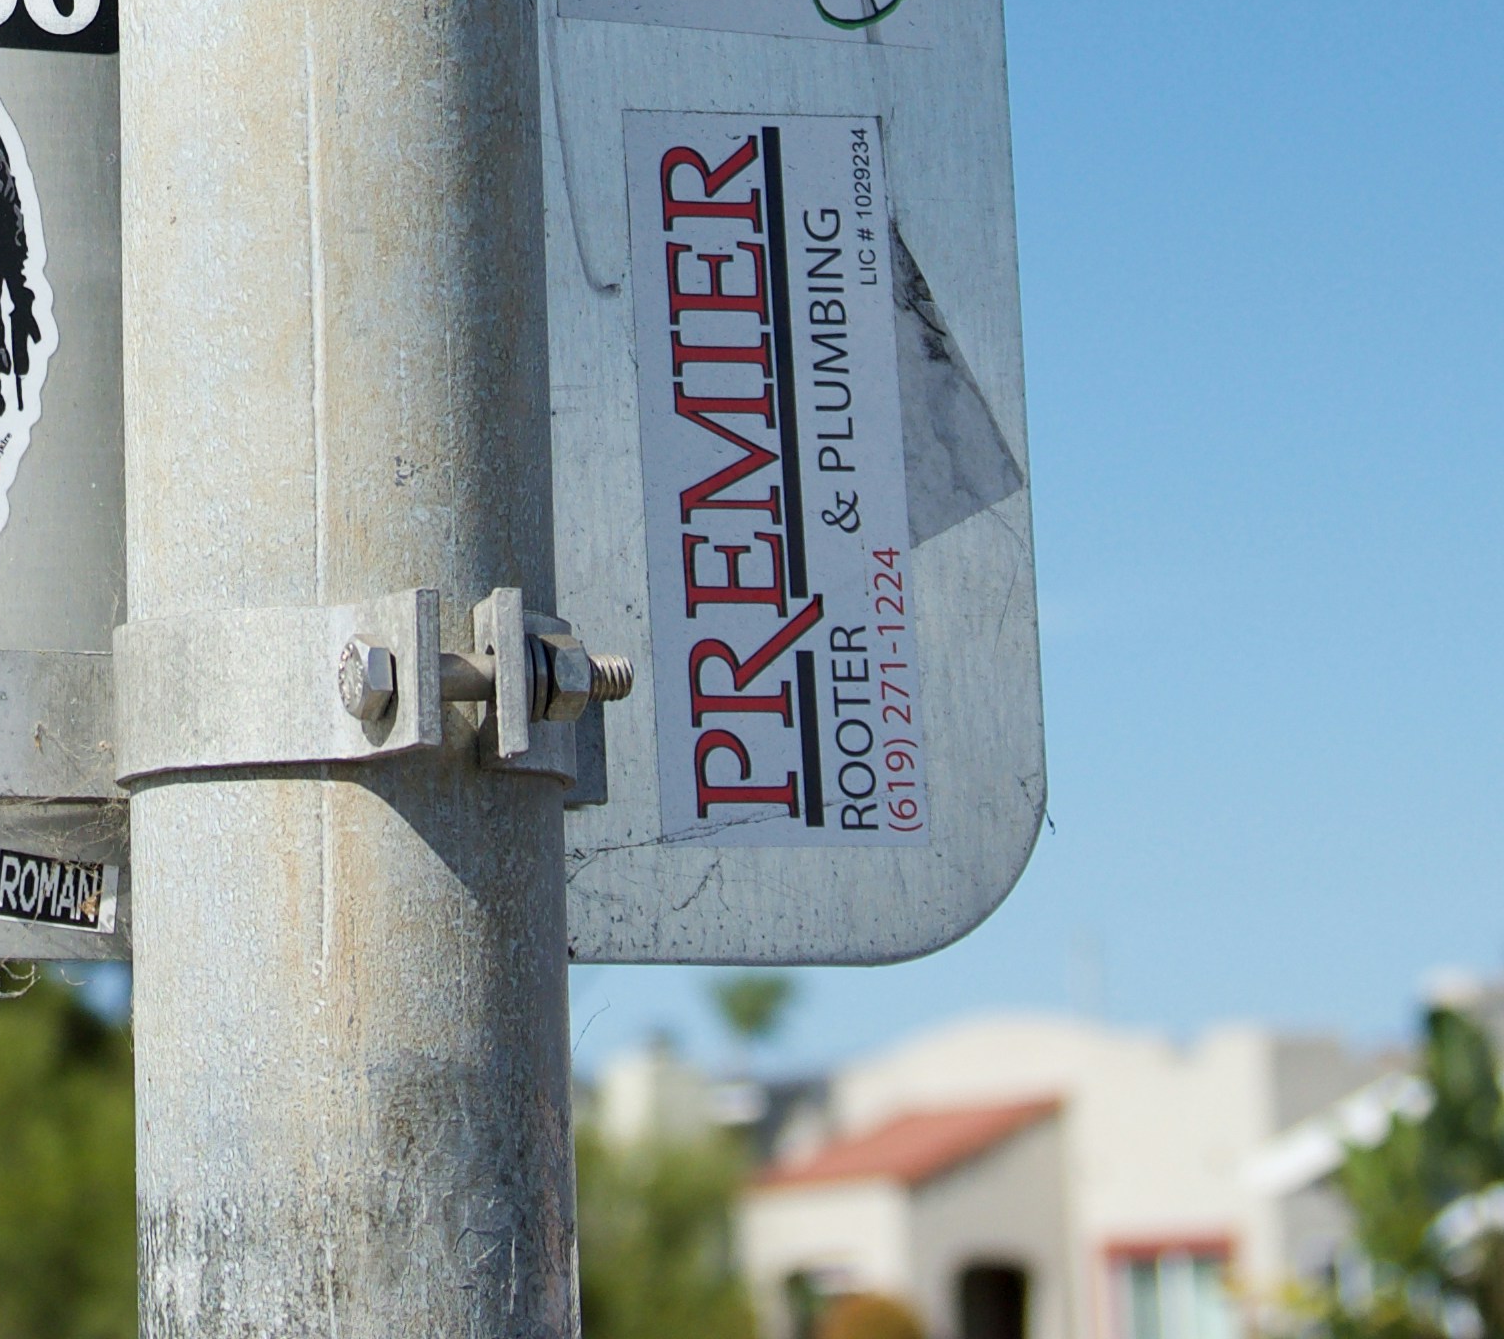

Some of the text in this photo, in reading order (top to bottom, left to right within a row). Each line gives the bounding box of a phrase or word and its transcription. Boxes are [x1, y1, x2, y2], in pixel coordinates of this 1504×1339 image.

[852, 128, 877, 285] LIC # 1029234
[660, 135, 825, 819] PREMIER
[803, 208, 879, 830] ROOTER & PLUMBING
[872, 547, 923, 833] (619) 271-1224
